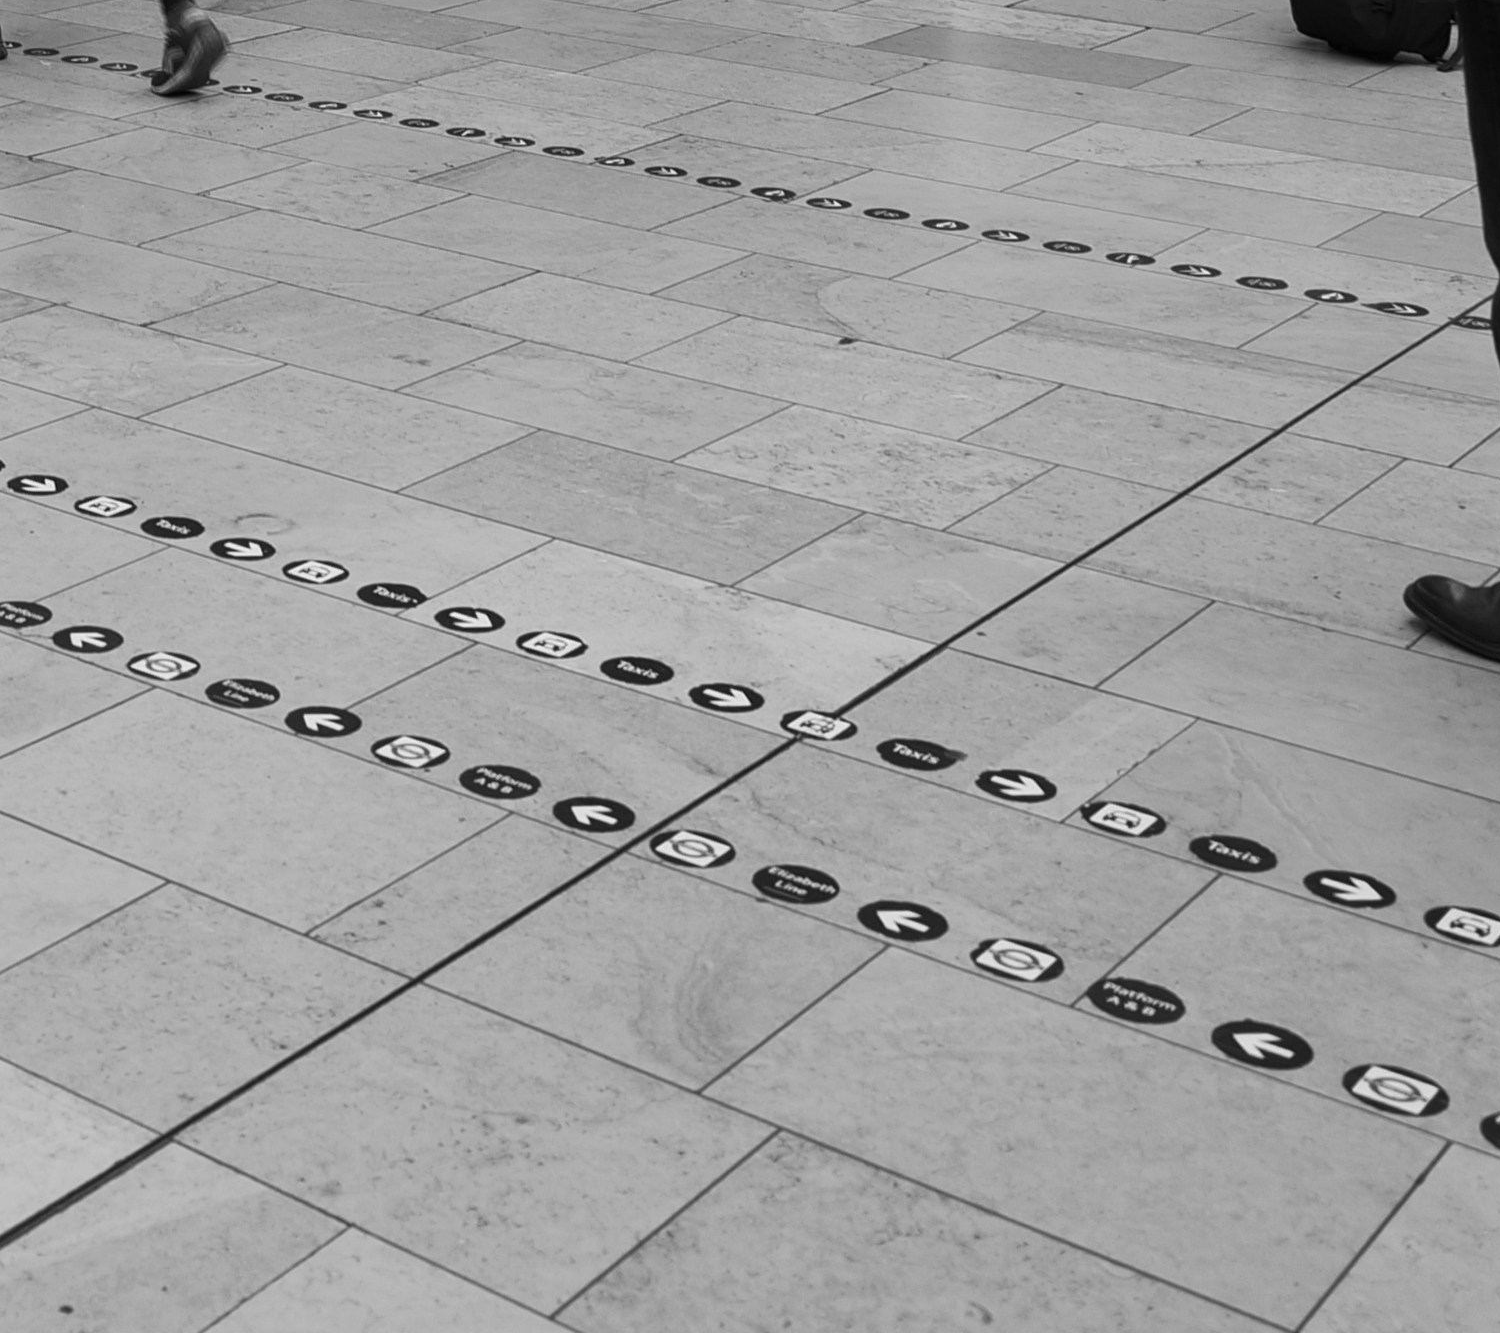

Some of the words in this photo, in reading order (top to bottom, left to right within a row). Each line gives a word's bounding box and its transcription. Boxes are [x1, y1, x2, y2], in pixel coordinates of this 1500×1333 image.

[373, 586, 411, 604] Taxis
[617, 660, 659, 679] Taxis
[893, 742, 940, 765] Taxis
[1208, 840, 1260, 865] Taxis
[767, 866, 837, 895] Elizabeth
[774, 879, 808, 896] Line
[1102, 980, 1178, 1012] Platform
[1105, 995, 1121, 1006] A
[1141, 1005, 1156, 1017] B
